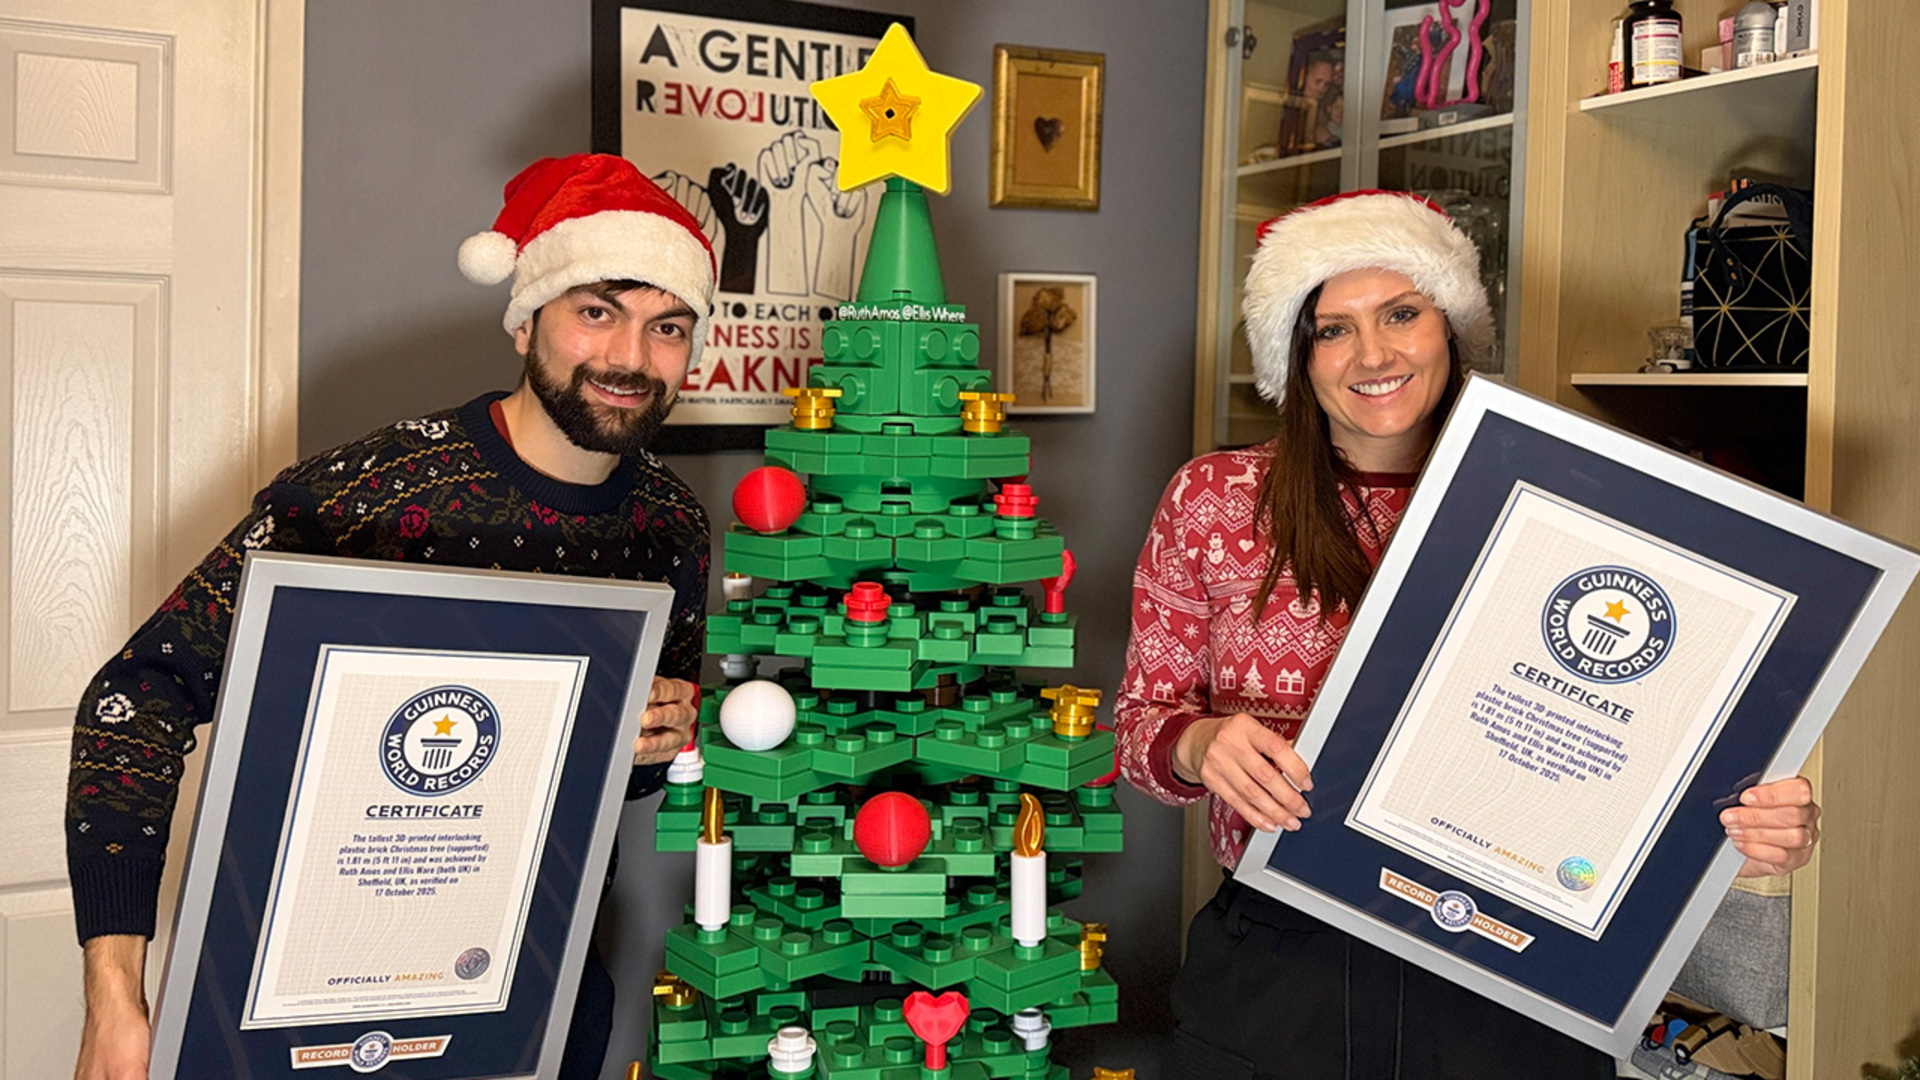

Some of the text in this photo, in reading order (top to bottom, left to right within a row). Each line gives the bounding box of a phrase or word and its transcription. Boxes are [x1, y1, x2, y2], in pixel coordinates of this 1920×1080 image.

[639, 23, 679, 68] A
[722, 301, 748, 319] TO
[755, 303, 811, 322] EACH
[838, 304, 900, 321] @RuthAmos
[790, 326, 811, 350] IS
[1578, 573, 1667, 622] GUINNESS
[1549, 599, 1664, 677] WORLD RECORDS
[1513, 662, 1634, 722] CERTIFICATE
[404, 692, 489, 722] GUINNESS
[1492, 684, 1506, 696] The
[1507, 690, 1533, 708] tallest
[1576, 720, 1623, 749] interlocking
[1471, 701, 1622, 773] is 1.81 m (5 ft 11 in) and was achieved by
[1475, 690, 1628, 763] plastic brick Christmas tree (supported)
[1470, 711, 1613, 780] Ruth Amos and Ellis Ware (both UK) in
[1485, 730, 1587, 781] Sheffield, UK, as verified on
[387, 733, 493, 790] WORLD RECORDS
[1499, 750, 1508, 759] 17
[1508, 754, 1539, 773] October
[366, 804, 484, 817] CERTIFICATE
[339, 846, 365, 855] plastic
[390, 845, 427, 853] Christmas
[447, 844, 489, 853] (supported)
[353, 834, 366, 843] The
[438, 834, 481, 842] interlocking
[1430, 816, 1493, 849] OFFICIALLY
[1494, 847, 1546, 874] AMAZING
[337, 857, 344, 865] is
[346, 856, 361, 864] 1.81
[372, 856, 381, 865] (5
[383, 856, 390, 864] ft
[401, 856, 411, 864] in)
[445, 855, 476, 863] achieved
[478, 855, 486, 863] by
[339, 868, 358, 876] Ruth
[383, 867, 397, 875] and
[399, 867, 414, 875] Ellis
[416, 866, 434, 874] Ware
[436, 866, 456, 875] (both
[358, 878, 392, 886] Sheffield,
[395, 878, 406, 886] UK,
[375, 888, 383, 897] 17
[385, 888, 414, 896] October
[1387, 877, 1519, 943] RECORD HOLDER
[328, 972, 445, 986] OFFICIALLY AMAZING
[301, 1042, 437, 1060] RECORD HOLDER
